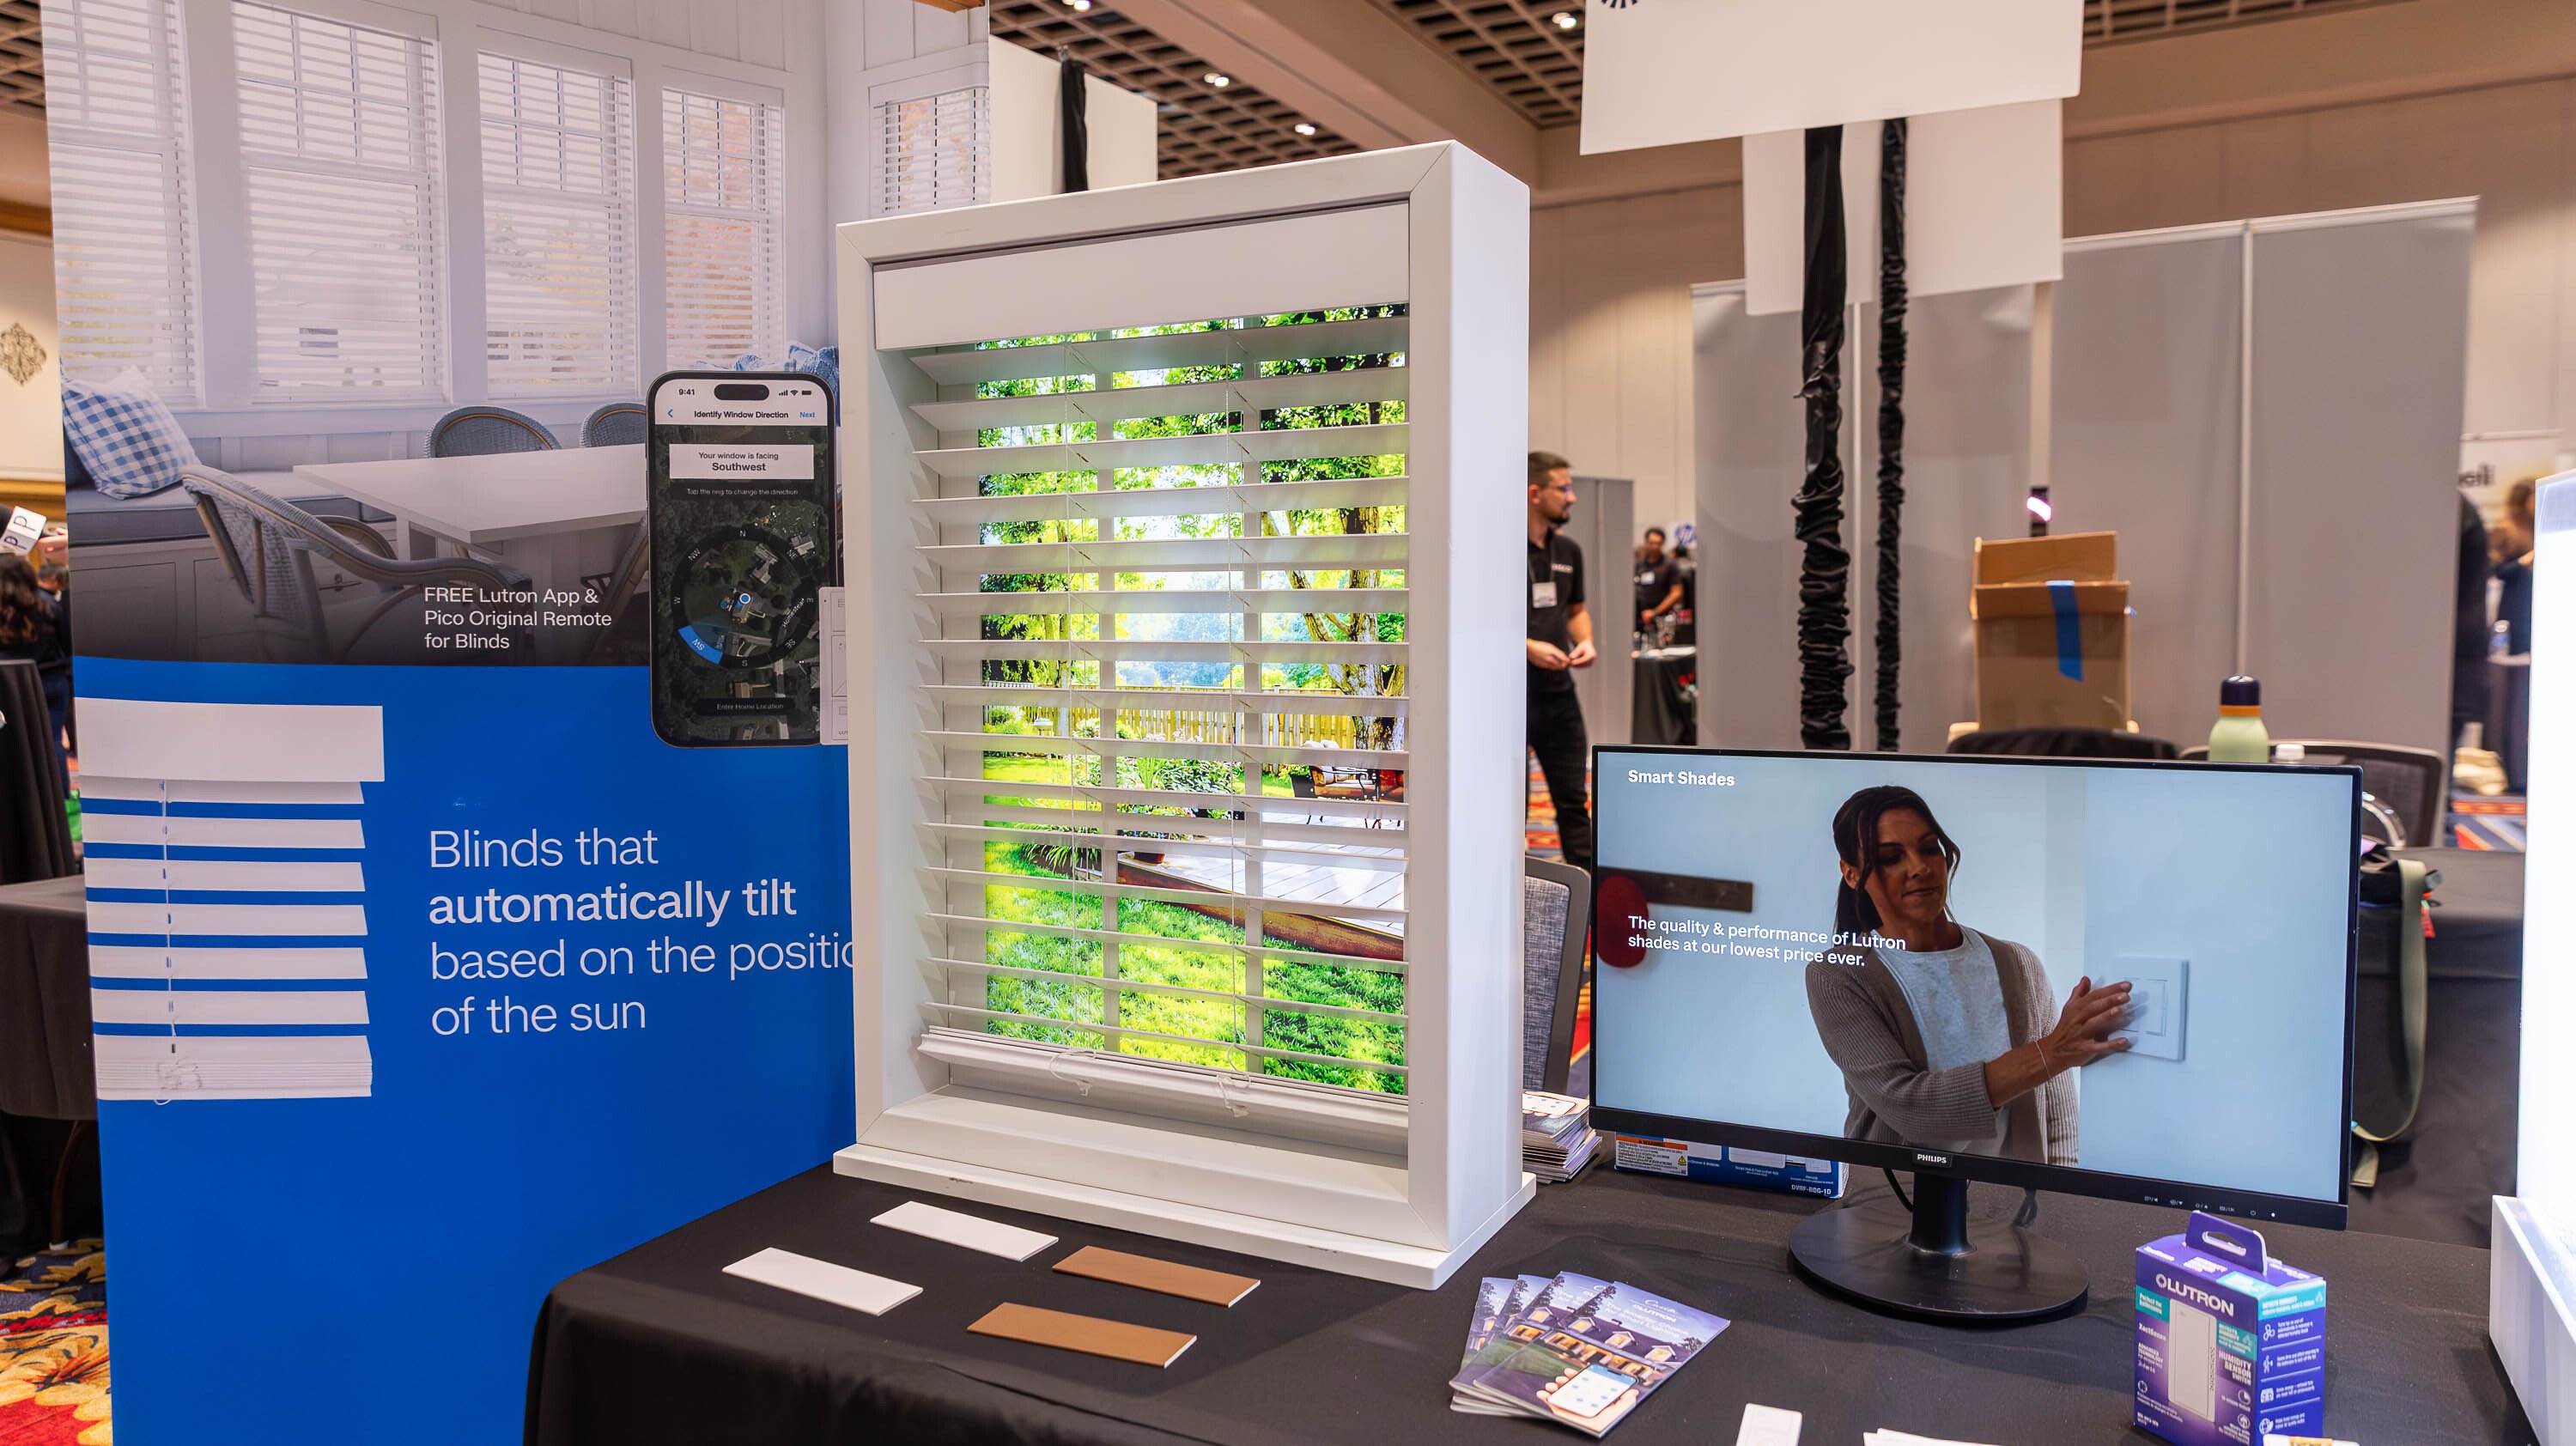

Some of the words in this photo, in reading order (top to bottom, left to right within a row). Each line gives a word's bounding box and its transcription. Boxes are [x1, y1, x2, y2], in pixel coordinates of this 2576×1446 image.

[695, 410, 722, 419] Identify
[712, 462, 766, 471] Southwest
[424, 587, 473, 603] FREE
[479, 587, 538, 603] Lutron
[543, 588, 580, 607] App
[585, 588, 598, 604] &
[425, 610, 464, 625] Pico
[469, 611, 538, 629] Original
[544, 611, 612, 626] Remote
[424, 632, 450, 648] for
[455, 633, 510, 648] Blinds
[1628, 769, 1674, 785] Smart
[1677, 771, 1735, 787] Shades
[430, 828, 563, 868] Blinds
[574, 828, 659, 866] that
[428, 880, 731, 927] automatically
[742, 878, 797, 917] tilt
[1628, 915, 1656, 930] The
[1660, 918, 1710, 937] quality
[1713, 922, 1724, 936] &
[1728, 924, 1828, 945] performance
[1832, 931, 1850, 945] of
[1851, 932, 1906, 951] Lutron
[431, 939, 566, 980] based
[580, 946, 634, 975] on
[647, 936, 716, 974] the
[1628, 934, 1680, 951] shades
[1683, 938, 1698, 952] at
[1701, 943, 1727, 955] our
[1729, 941, 1780, 960] lowest
[1783, 948, 1824, 963] price
[1827, 953, 1865, 967] ever.
[431, 996, 475, 1036] of
[486, 995, 557, 1034] the
[570, 999, 646, 1030] sun
[1917, 1153, 1947, 1163] PHILIPS
